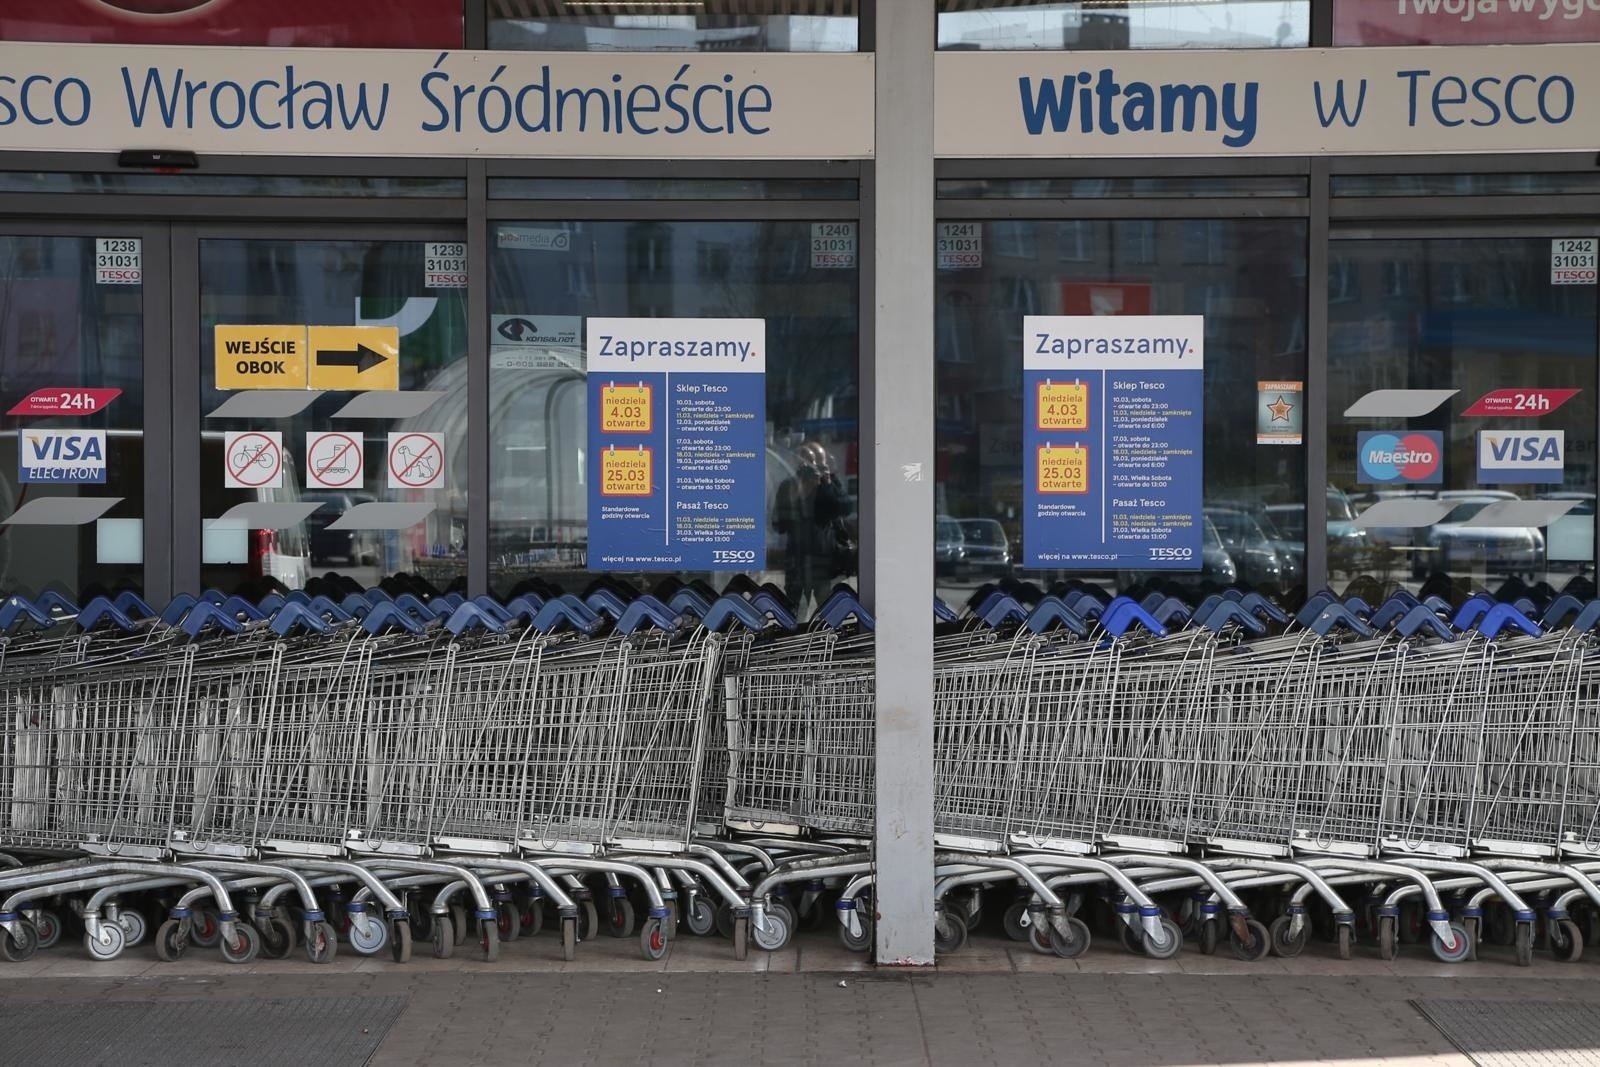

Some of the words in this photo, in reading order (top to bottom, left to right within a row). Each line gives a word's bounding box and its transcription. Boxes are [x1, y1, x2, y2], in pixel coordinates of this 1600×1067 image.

[121, 65, 389, 130] Wrocław
[420, 52, 772, 135] Śródmieście
[1018, 69, 1259, 148] Witamy
[1397, 70, 1575, 127] Tesco
[817, 224, 850, 237] 1240
[944, 225, 975, 236] 1241
[102, 240, 136, 253] 1238
[431, 244, 463, 257] 1239
[813, 239, 853, 252] 31031
[939, 239, 979, 251] 31031
[1559, 240, 1592, 252] 1242
[97, 254, 140, 268] 31031
[815, 254, 854, 264] TESCO
[942, 254, 980, 264] TESCO
[1554, 255, 1594, 267] 31031
[426, 258, 467, 272] 31031
[100, 269, 141, 280] TESCO
[429, 273, 468, 283] TESCO
[1554, 271, 1596, 280] TESCO
[225, 337, 296, 355] WEJŚCIE
[599, 336, 756, 362] Zapraszamy.
[1036, 334, 1194, 359] Zapraszamy.
[236, 361, 285, 374] OBOK
[676, 384, 700, 395] Sklep
[703, 384, 728, 393] Tesco
[1113, 381, 1137, 392] Sklep
[1140, 382, 1165, 390] Tesco
[60, 393, 95, 409] 24h
[606, 397, 646, 405] niedziela
[1043, 394, 1082, 402] niedziela
[1514, 394, 1549, 410] 24h
[611, 407, 641, 418] 4.03
[1047, 404, 1077, 416] 4.03
[26, 436, 102, 461] VISA
[1484, 437, 1560, 461] VISA
[1042, 458, 1082, 466] niedziela
[1369, 450, 1432, 464] Maestro
[606, 460, 646, 468] niedziela
[29, 468, 99, 479] ELECTRON
[607, 470, 645, 481] 25.03
[1043, 468, 1081, 479] 25.03
[606, 483, 646, 491] otwarte
[676, 501, 701, 510] Pasaż
[703, 502, 728, 510] Tesco
[1113, 499, 1137, 507] Pasaż
[1140, 499, 1165, 507] Tesco
[713, 550, 755, 559] TESCO
[1038, 553, 1060, 561] więcej
[1072, 553, 1118, 561] www.tesco.pl
[1149, 548, 1192, 556] TESCO
